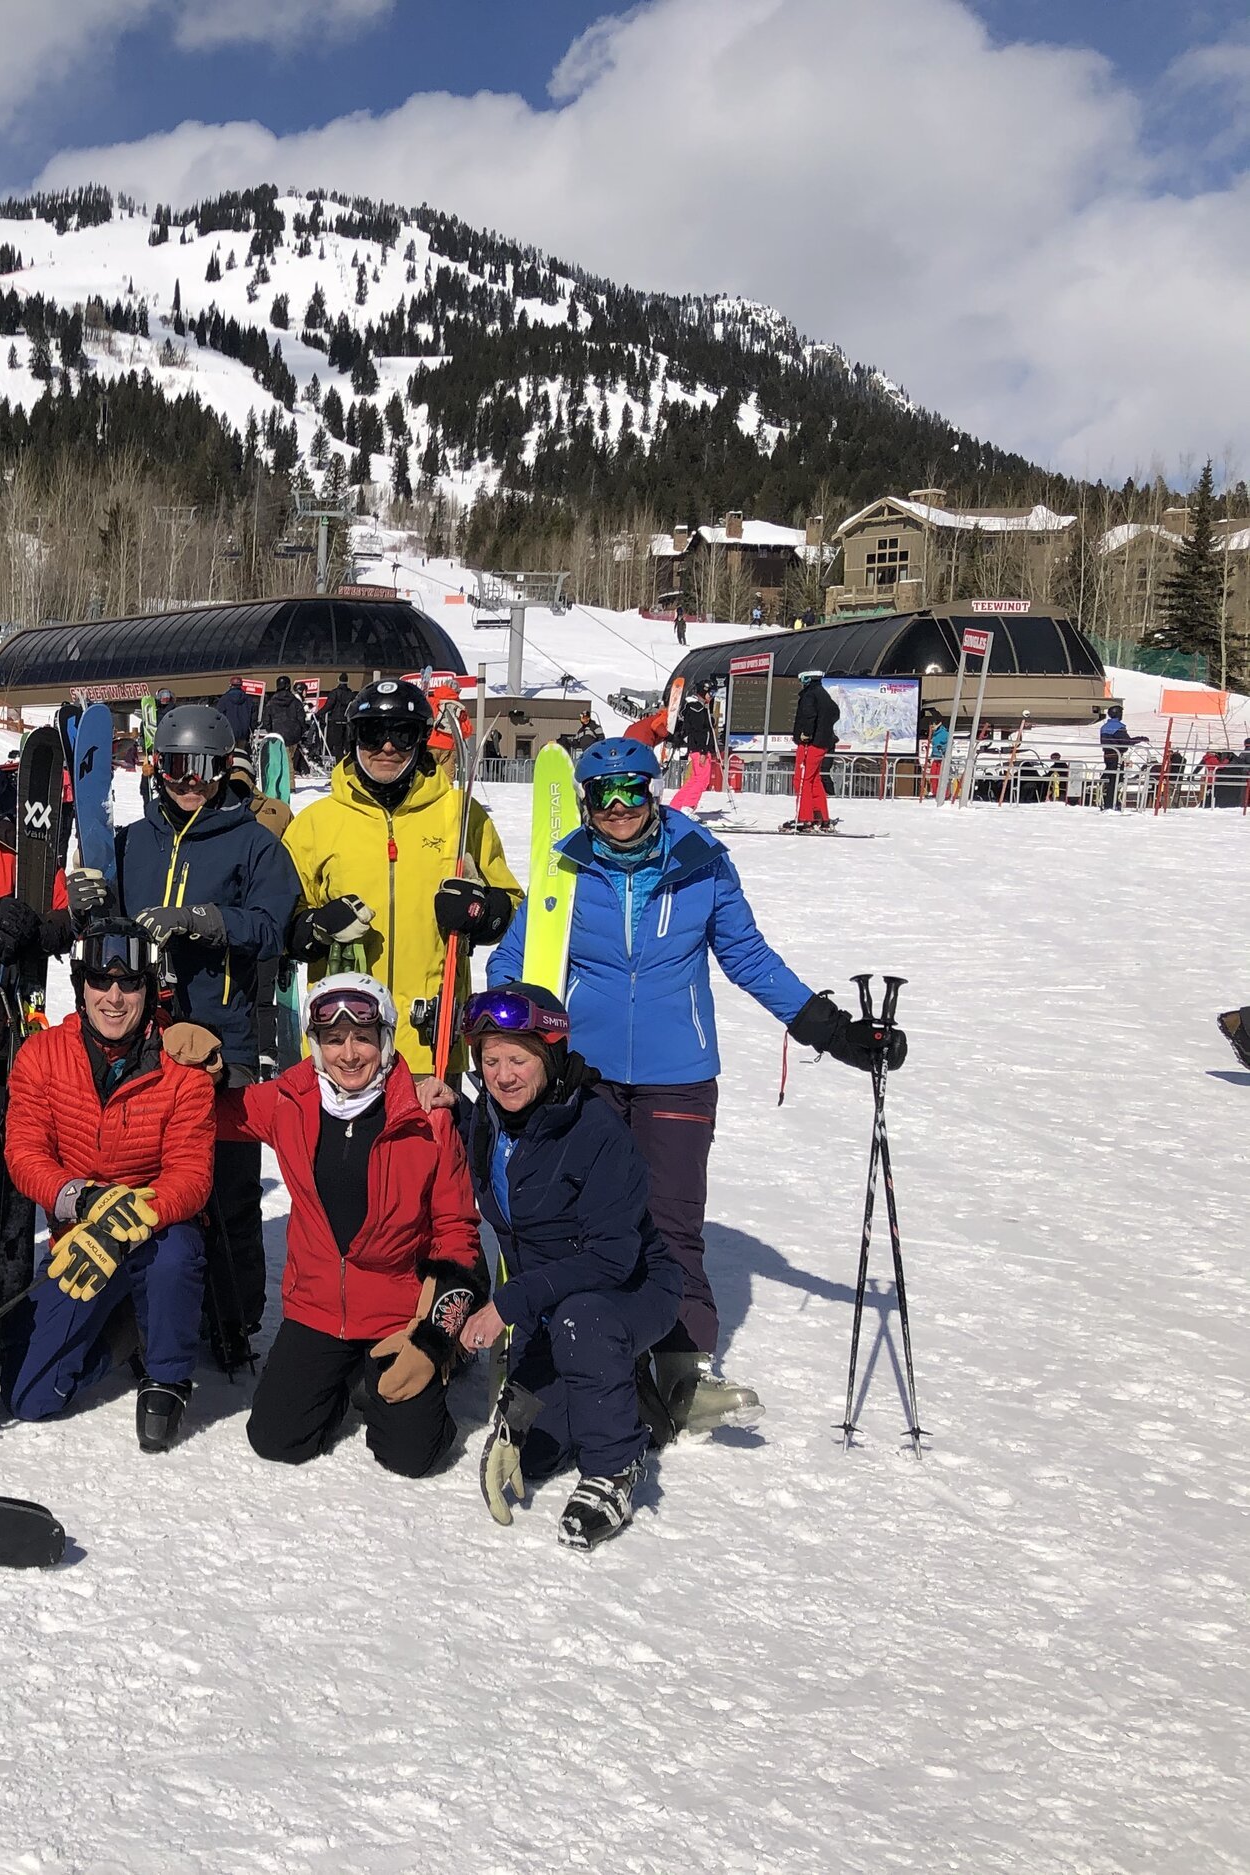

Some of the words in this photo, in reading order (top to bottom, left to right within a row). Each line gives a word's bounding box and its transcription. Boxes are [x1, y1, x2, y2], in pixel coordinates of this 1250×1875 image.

[972, 601, 1030, 612] TEEWINOT
[542, 1015, 568, 1028] SMITH
[97, 1190, 119, 1211] AUCLAIR
[85, 1240, 108, 1265] AUCLAIR
